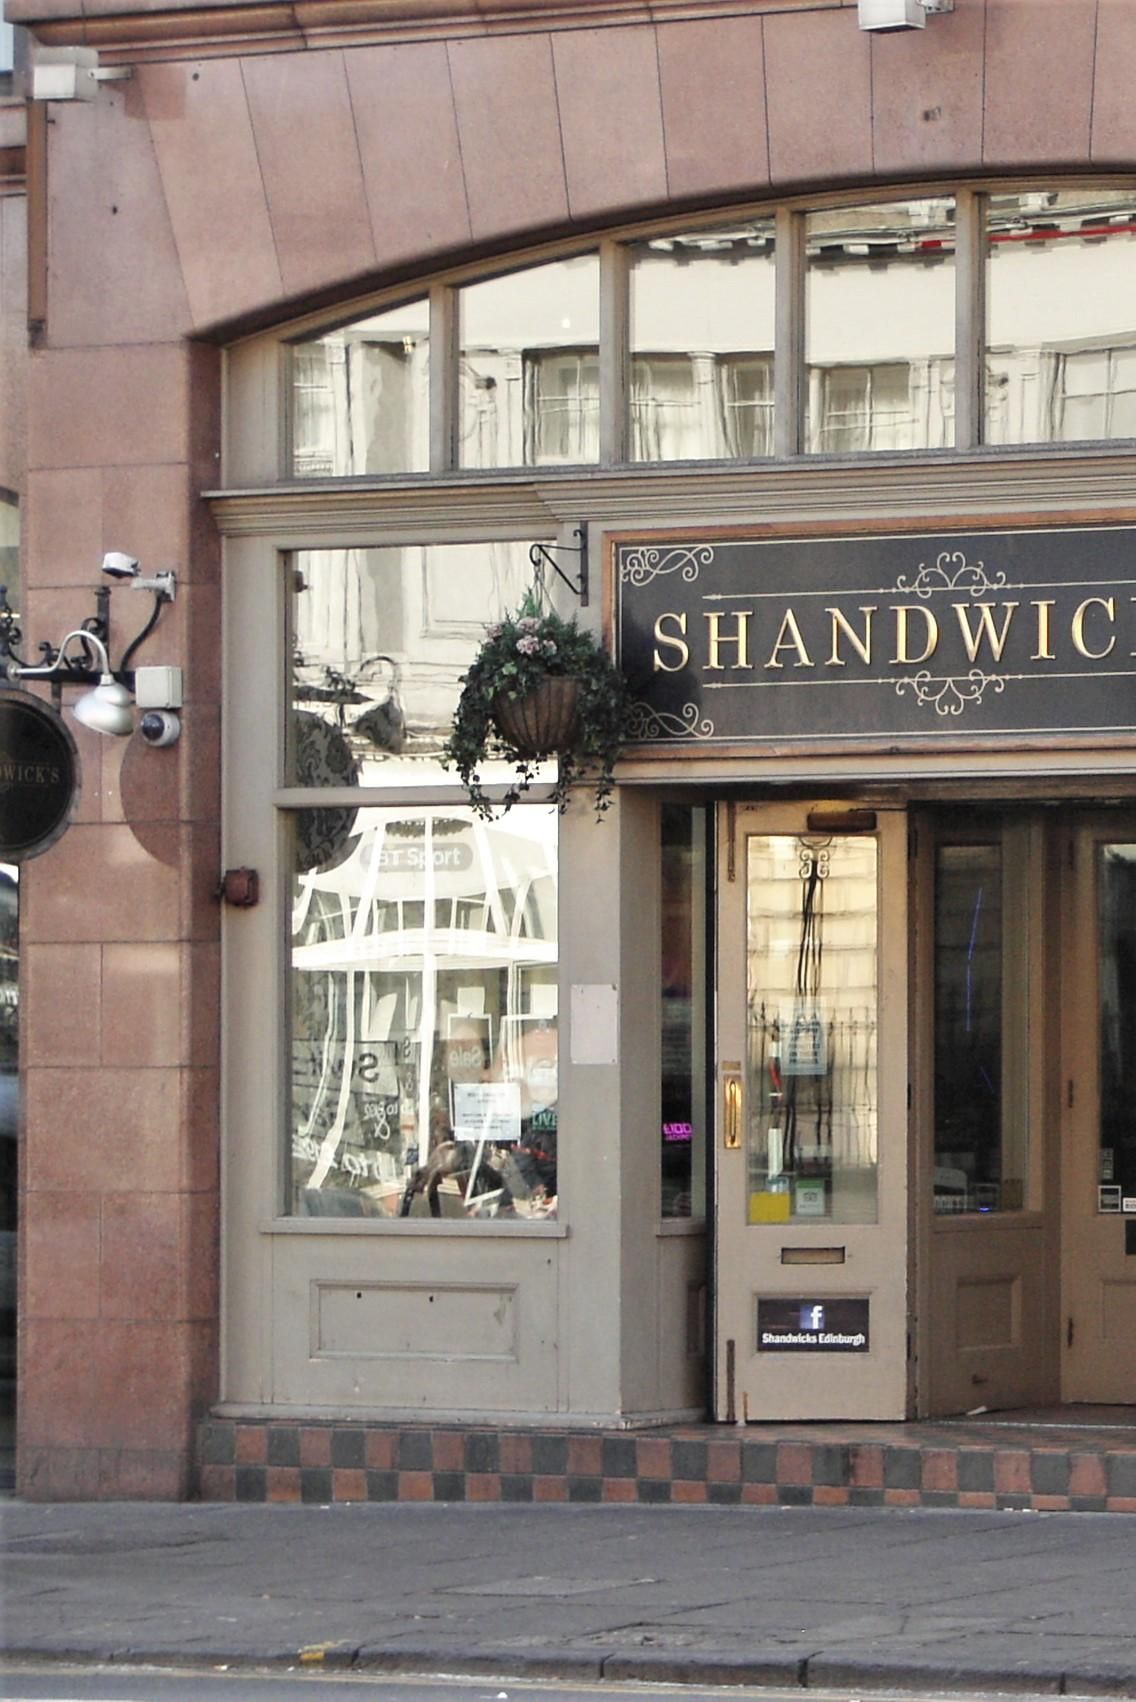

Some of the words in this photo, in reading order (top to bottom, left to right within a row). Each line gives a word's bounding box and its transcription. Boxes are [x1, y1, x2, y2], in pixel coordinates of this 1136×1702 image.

[0, 764, 60, 785] WICK'S
[762, 1332, 817, 1344] Shandwicks
[818, 1332, 865, 1346] Edinburgh
